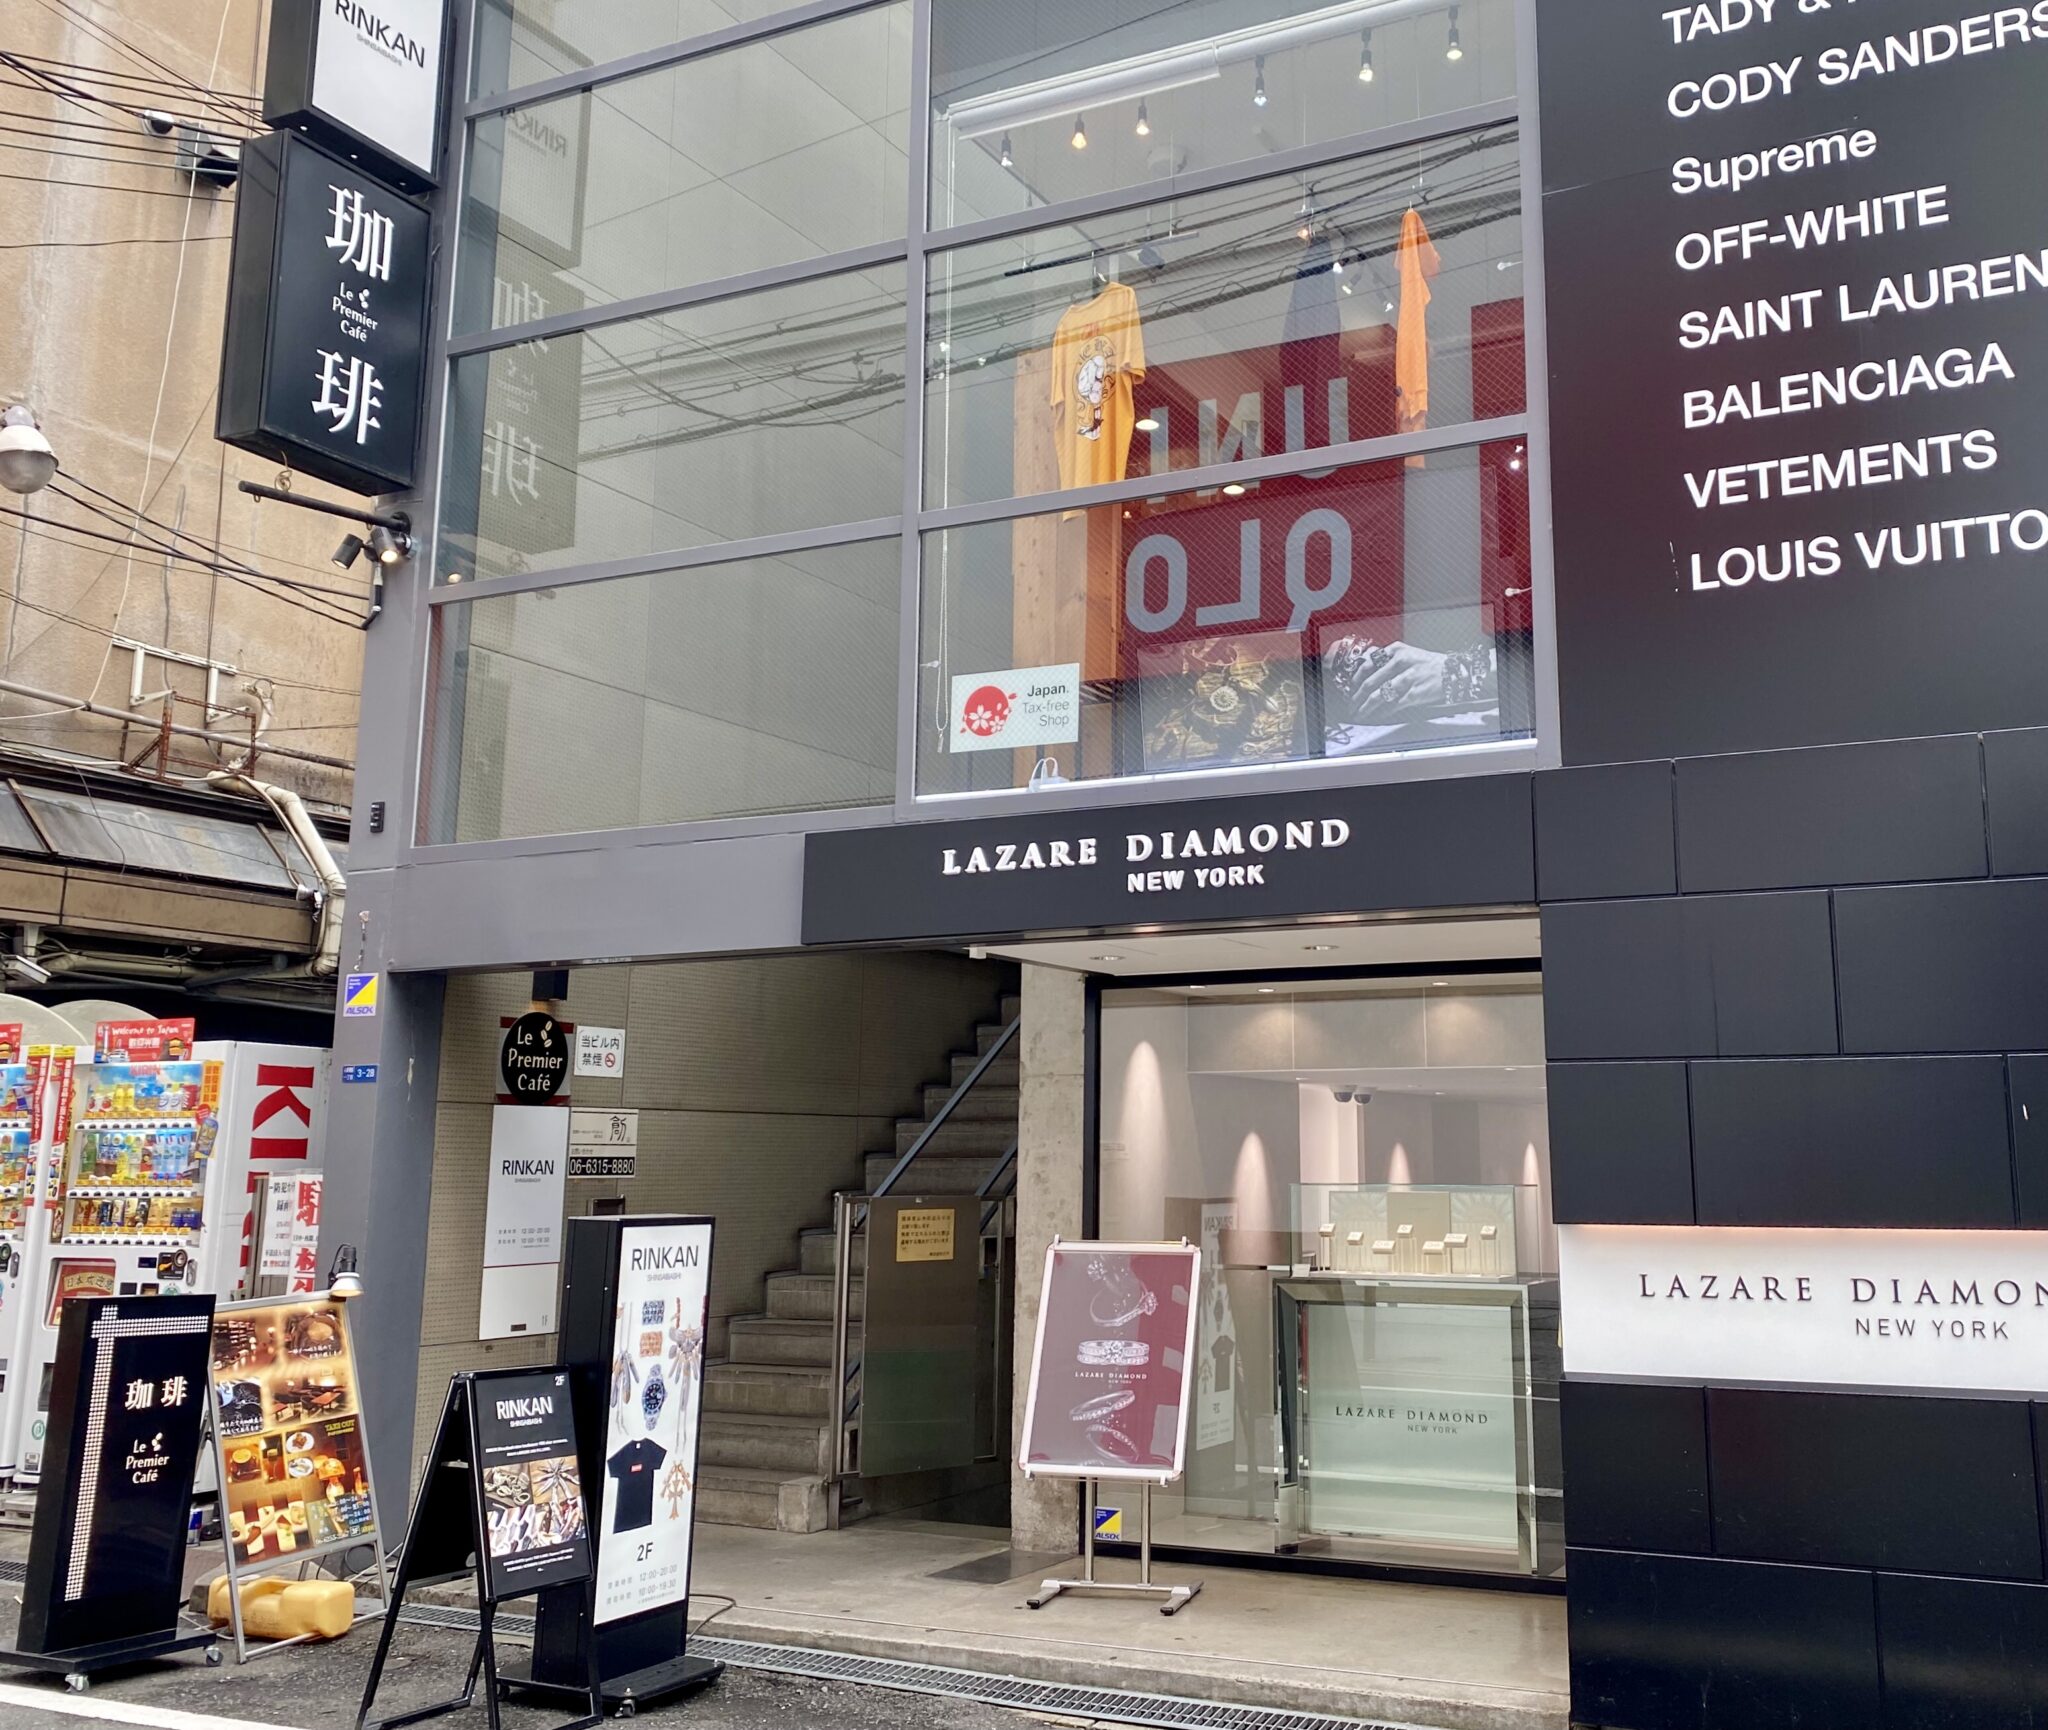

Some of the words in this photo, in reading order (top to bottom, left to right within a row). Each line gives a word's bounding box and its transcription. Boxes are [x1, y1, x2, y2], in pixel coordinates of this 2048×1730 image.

[1662, 0, 1776, 44] TADY
[336, 0, 425, 68] RINKAN
[1668, 56, 1802, 118] CODY
[1671, 129, 1877, 194] Supreme
[1675, 185, 1950, 270] OFF-WHITE
[339, 282, 354, 301] Le
[332, 296, 378, 331] Premier
[1679, 289, 1823, 349] SAINT
[340, 320, 367, 343] Café
[1683, 342, 2015, 429] BALENCIAGA
[1683, 429, 1997, 509] VETEMENTS
[1691, 535, 1841, 591] LOUIS
[1027, 684, 1070, 698] Japan.
[1022, 700, 1070, 714] Tax-free
[1039, 714, 1070, 727] Shop
[942, 838, 1097, 875] LAZARE
[1126, 818, 1350, 862] DIAMOND
[1127, 869, 1185, 893] NEW
[1194, 864, 1265, 889] YORK
[517, 1025, 533, 1046] Le
[581, 1035, 620, 1050] 当ビル内
[508, 1047, 563, 1069] Premier
[582, 1052, 602, 1067] 禁煙
[517, 1073, 551, 1092] Café
[502, 1159, 554, 1176] RINKAN
[570, 1158, 634, 1174] 06-6315-8880
[631, 1245, 699, 1271] RINKAN
[1639, 1273, 1814, 1303] LAZARE
[1856, 1318, 1916, 1338] NEW
[1931, 1320, 2010, 1340] YORK
[554, 1375, 565, 1386] 2F
[1108, 1372, 1147, 1380] DIAMOND
[124, 1376, 189, 1411] 珈琲
[496, 1395, 553, 1420] RINKAN
[1335, 1406, 1396, 1419] LAZARE
[1407, 1410, 1488, 1425] DIAMOND
[1407, 1424, 1428, 1433] NEW
[1432, 1426, 1458, 1435] YORK
[133, 1439, 147, 1454] Le
[125, 1453, 170, 1470] Premier
[132, 1469, 158, 1484] Café
[636, 1542, 654, 1562] 2F
